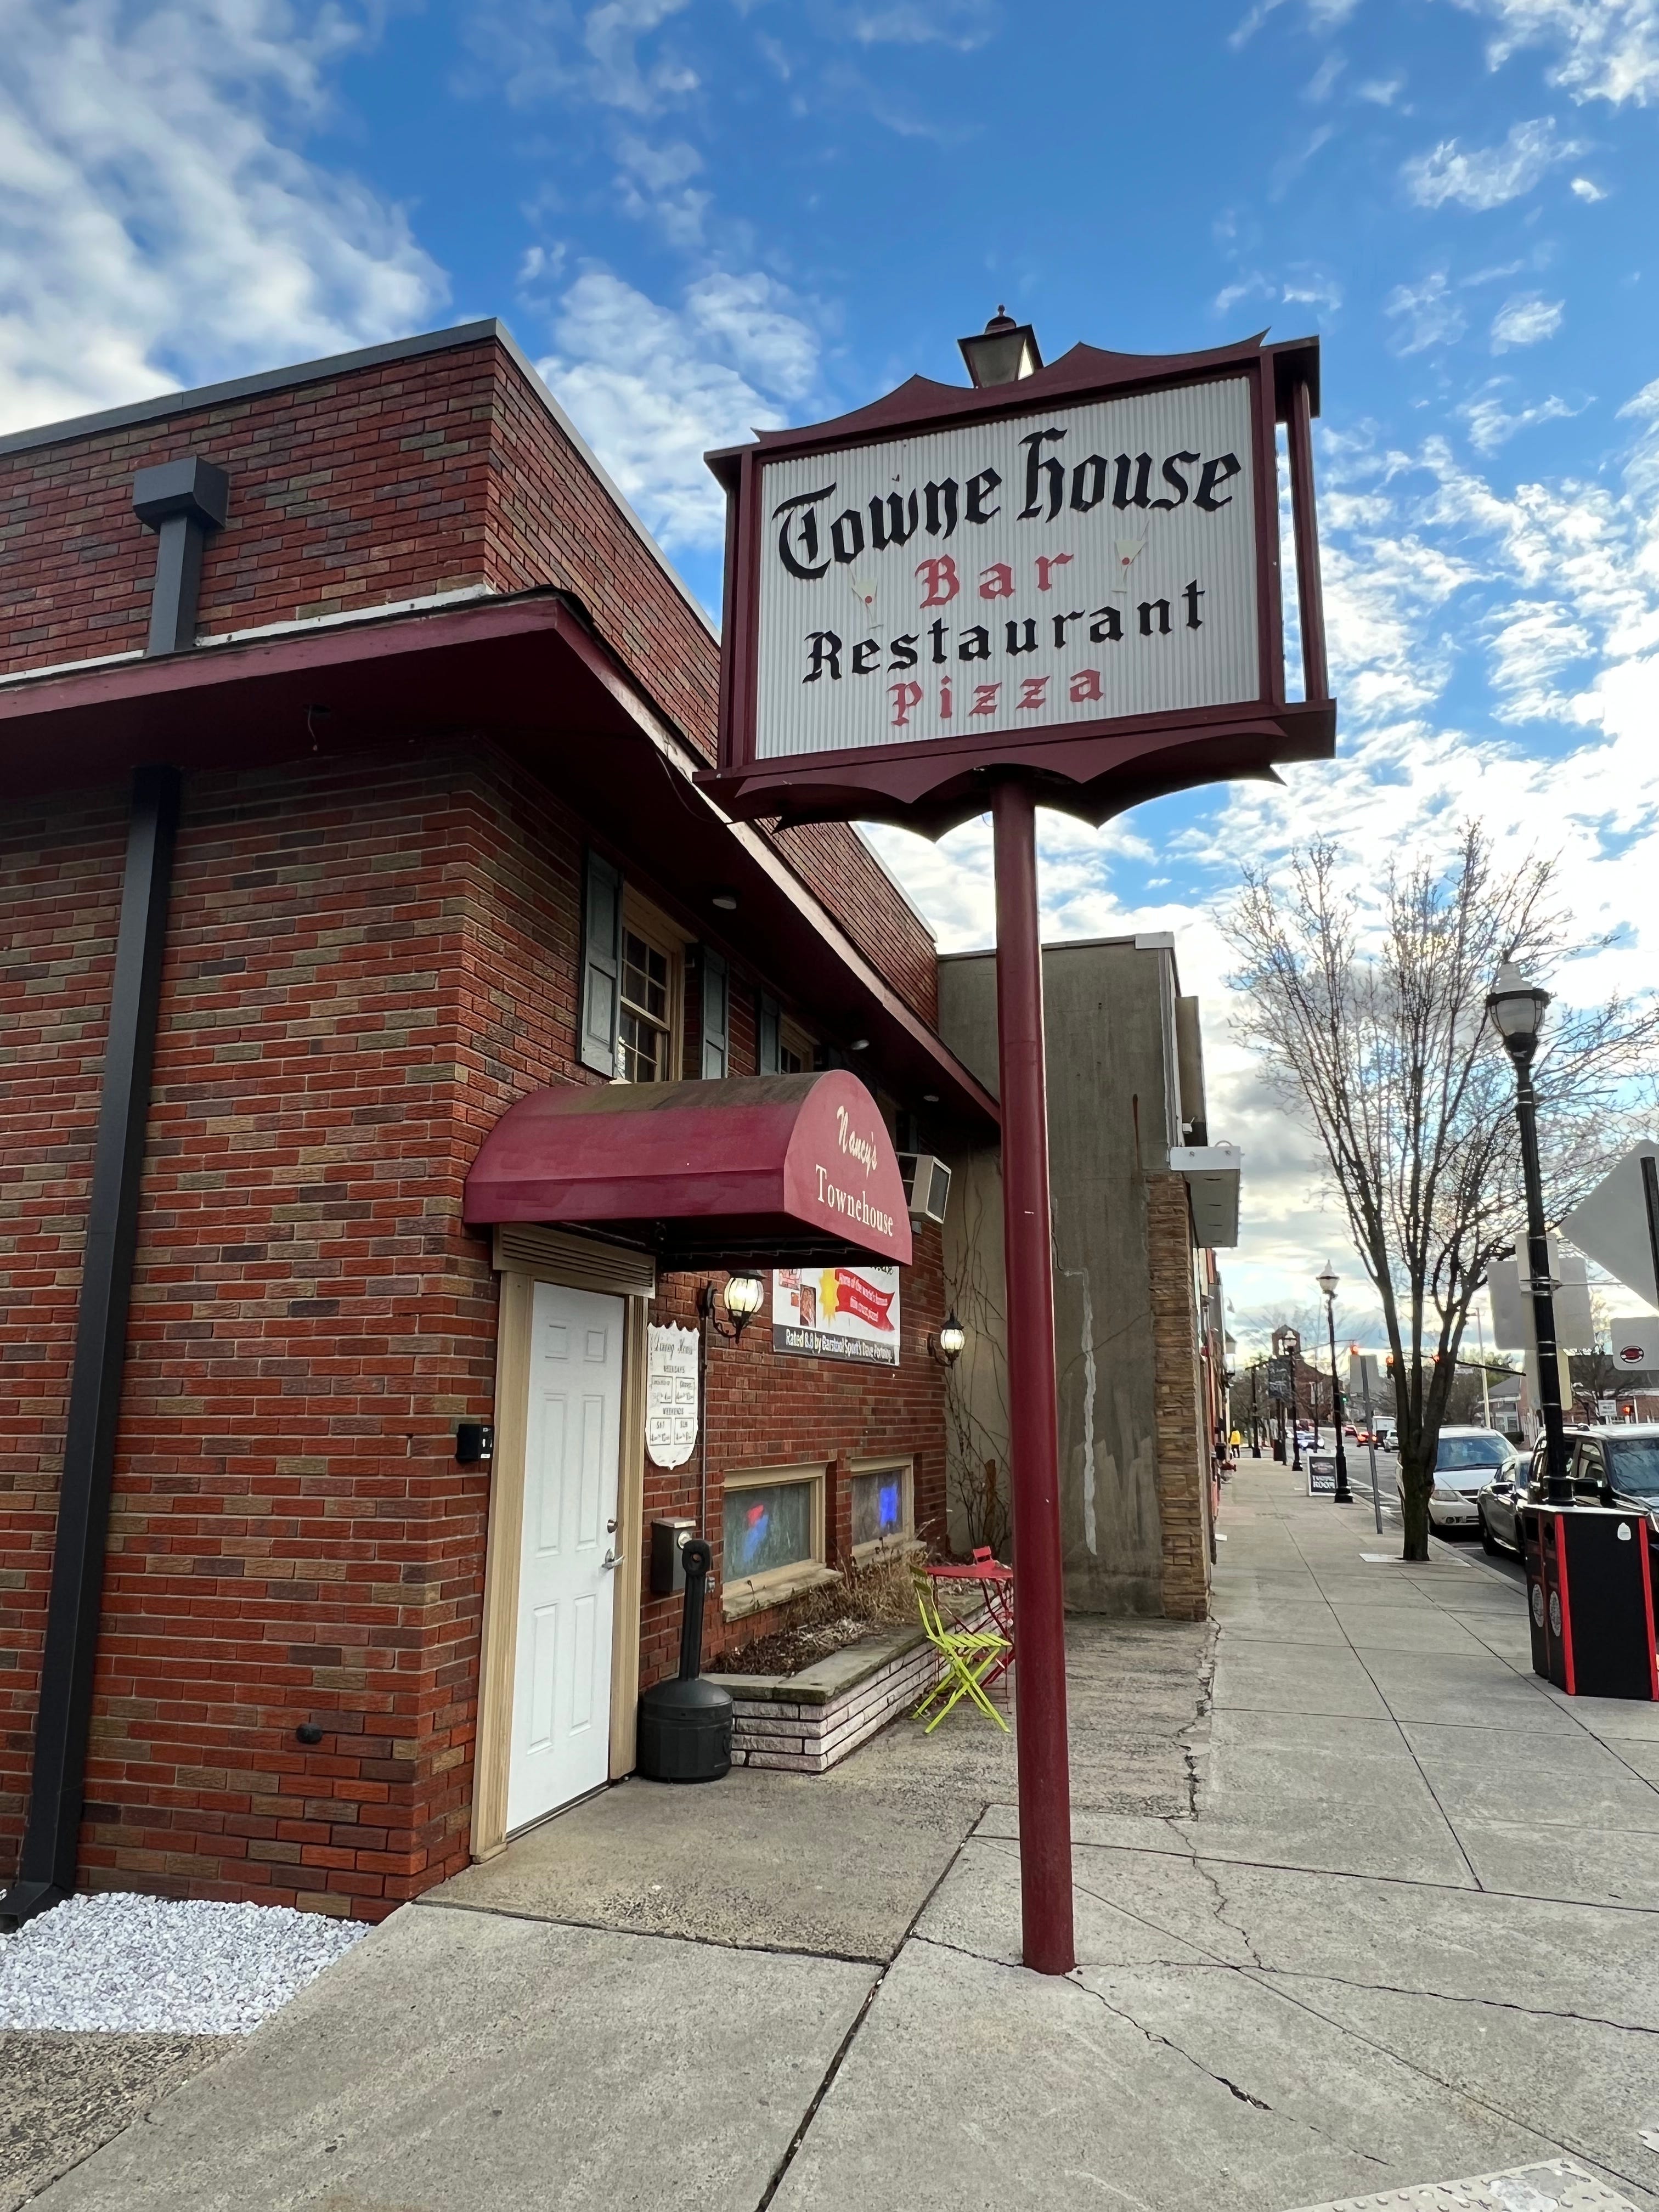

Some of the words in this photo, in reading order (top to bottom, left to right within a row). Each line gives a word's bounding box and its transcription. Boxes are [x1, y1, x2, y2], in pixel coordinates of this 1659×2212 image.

[772, 466, 1002, 580] Towne
[915, 552, 1074, 608] Bar
[802, 579, 1205, 684] Restaurant
[885, 668, 1104, 727] Pizza
[837, 1105, 877, 1178] Nancy's
[816, 1164, 893, 1237] Townehouse
[786, 1328, 804, 1347] Rated
[814, 1332, 822, 1354] by
